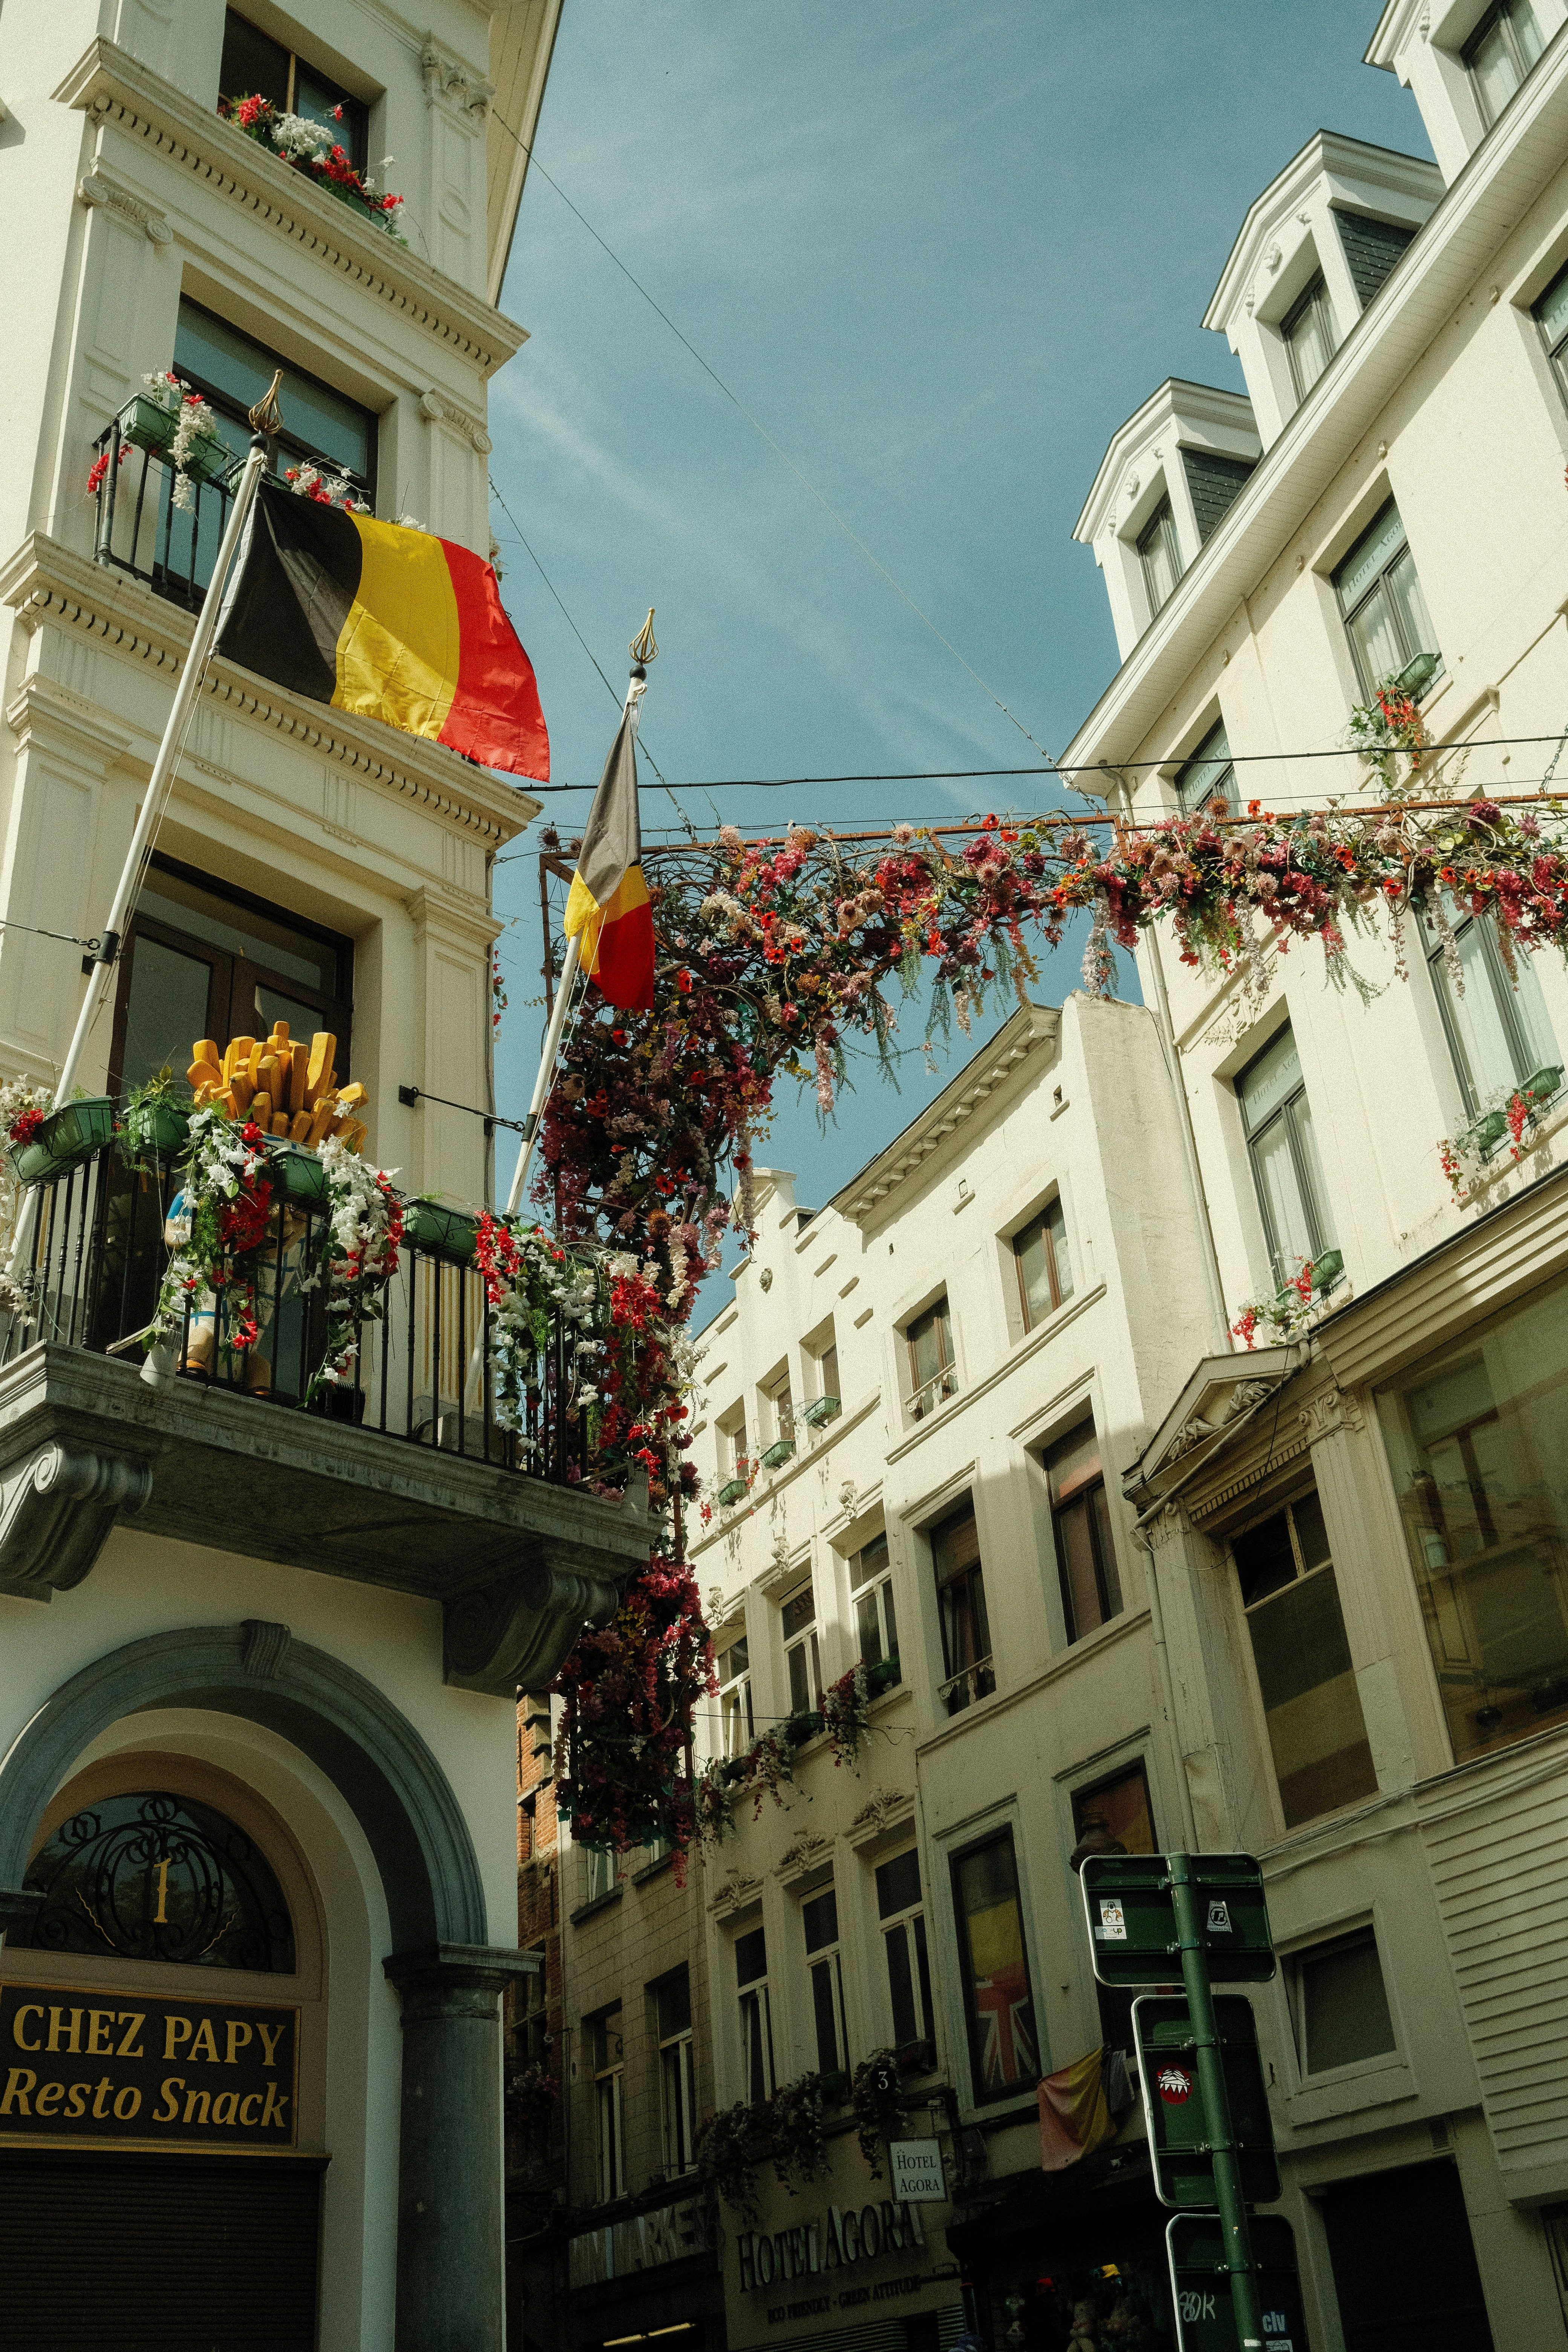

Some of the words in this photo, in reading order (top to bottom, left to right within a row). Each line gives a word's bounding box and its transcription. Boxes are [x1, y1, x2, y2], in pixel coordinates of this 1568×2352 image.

[154, 1858, 171, 1923] 1
[12, 2005, 146, 2056] CHEZ
[163, 2016, 286, 2066] PAPY
[0, 2067, 142, 2121] Resto
[152, 2078, 289, 2128] Snack
[878, 2071, 888, 2090] 3
[897, 2155, 936, 2169] HOTEL
[900, 2179, 940, 2192] AGORA
[737, 2223, 820, 2292] HOTEL
[824, 2200, 920, 2270] AGORA
[767, 2305, 785, 2324] ECO
[788, 2296, 831, 2319] FRIENDLY
[838, 2286, 871, 2308] GREEN
[873, 2275, 921, 2300] ATTITUDE
